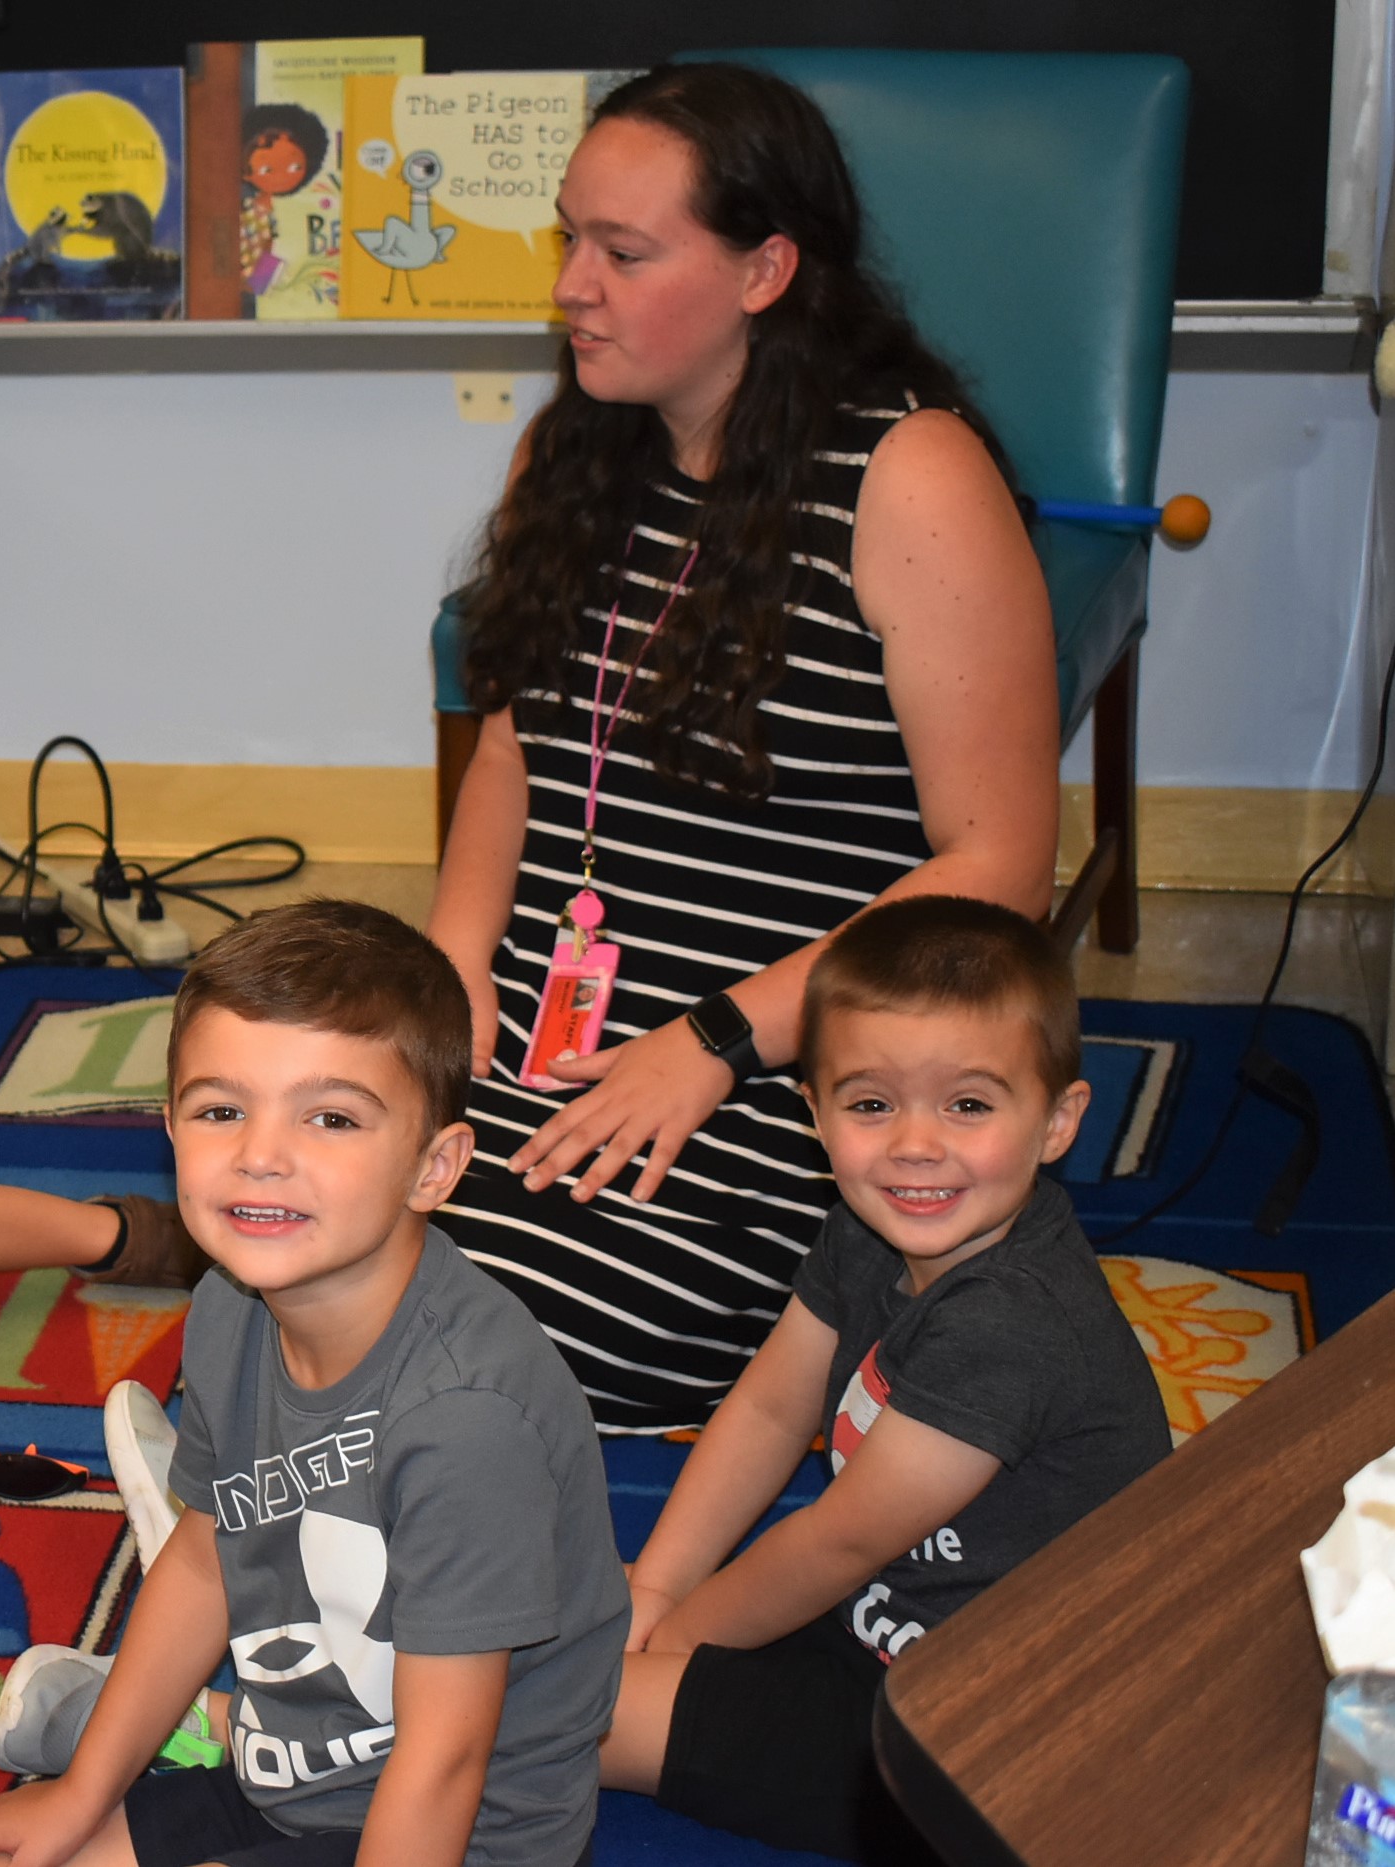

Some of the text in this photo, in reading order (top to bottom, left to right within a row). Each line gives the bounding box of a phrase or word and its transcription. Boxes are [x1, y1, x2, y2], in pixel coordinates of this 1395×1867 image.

[405, 90, 569, 118] The Pigeon
[471, 124, 568, 145] HAS to
[16, 141, 159, 164] The Kissing Hand
[487, 150, 567, 172] Go to
